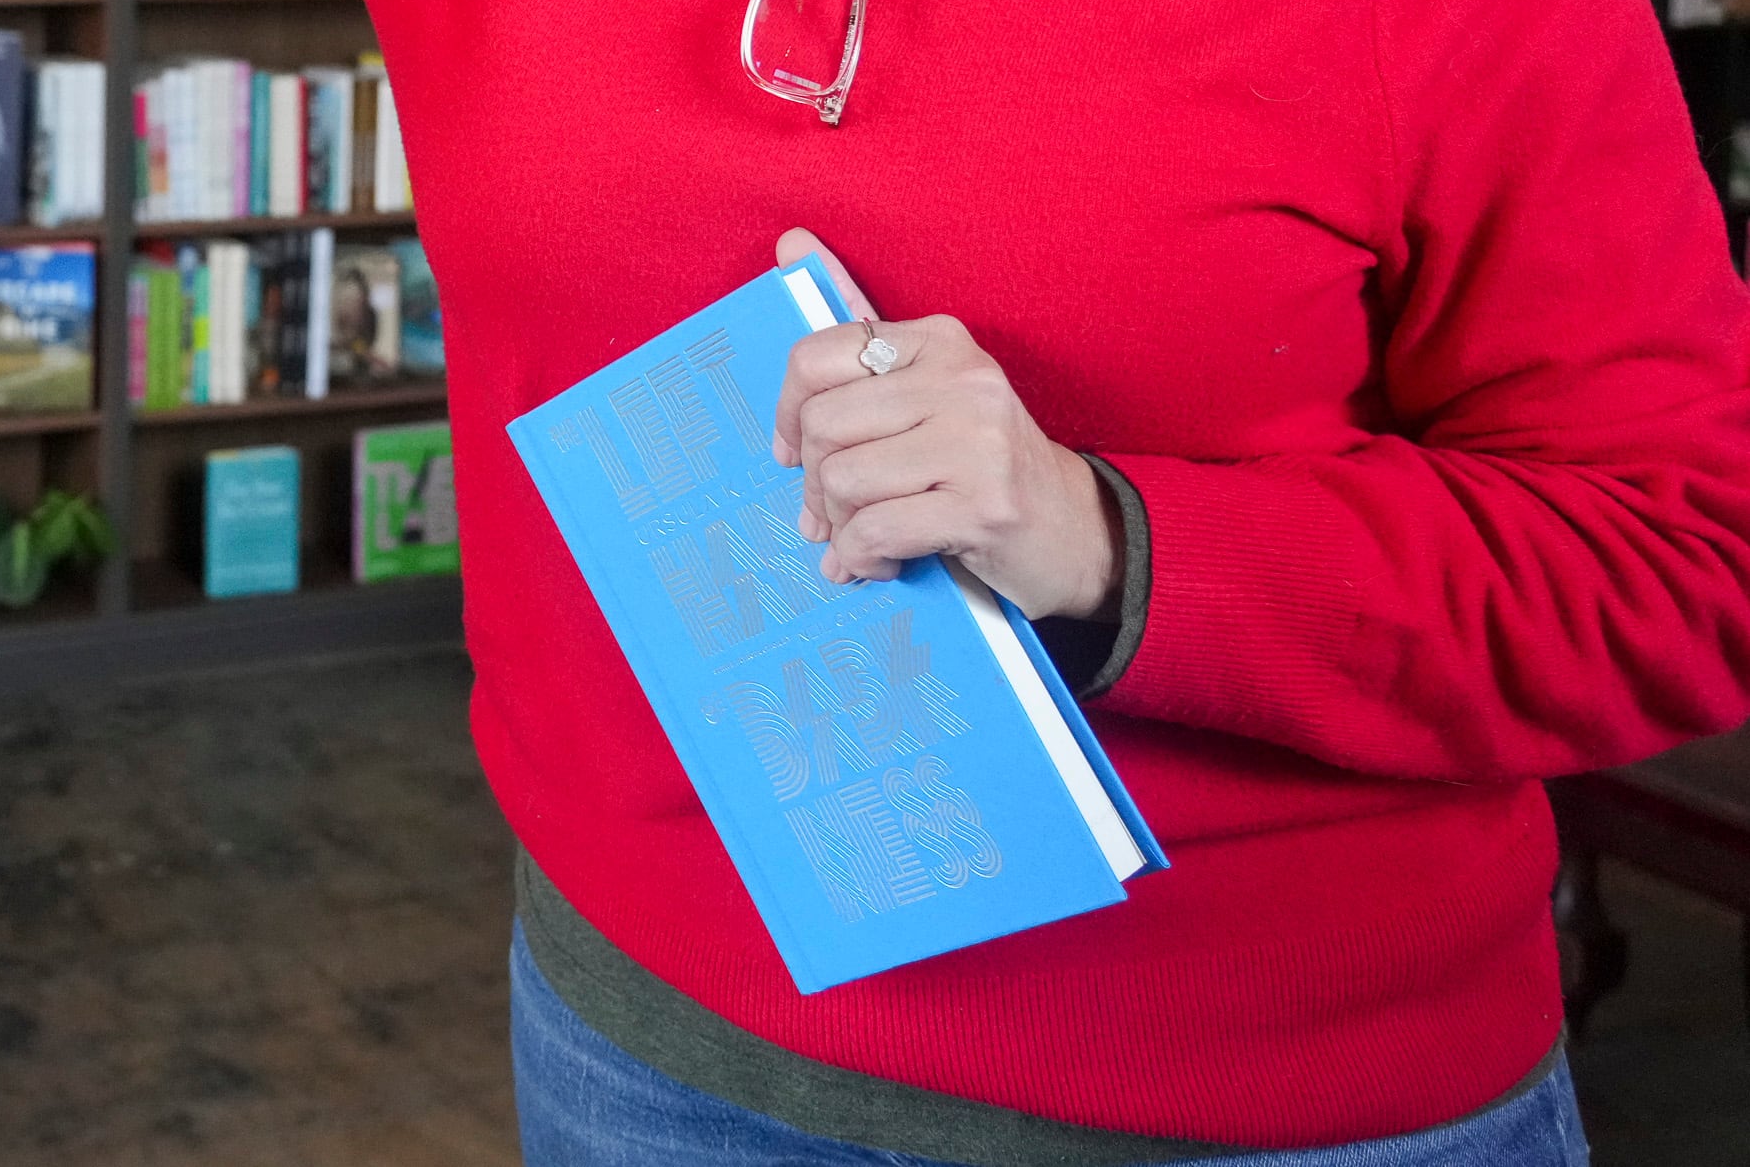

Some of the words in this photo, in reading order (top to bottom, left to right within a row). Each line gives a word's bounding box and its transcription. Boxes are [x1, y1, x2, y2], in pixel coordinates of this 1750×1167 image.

[576, 327, 773, 522] LEFT
[633, 493, 720, 545] URSULA
[648, 474, 872, 658] HAN
[783, 754, 1002, 924] NESS
